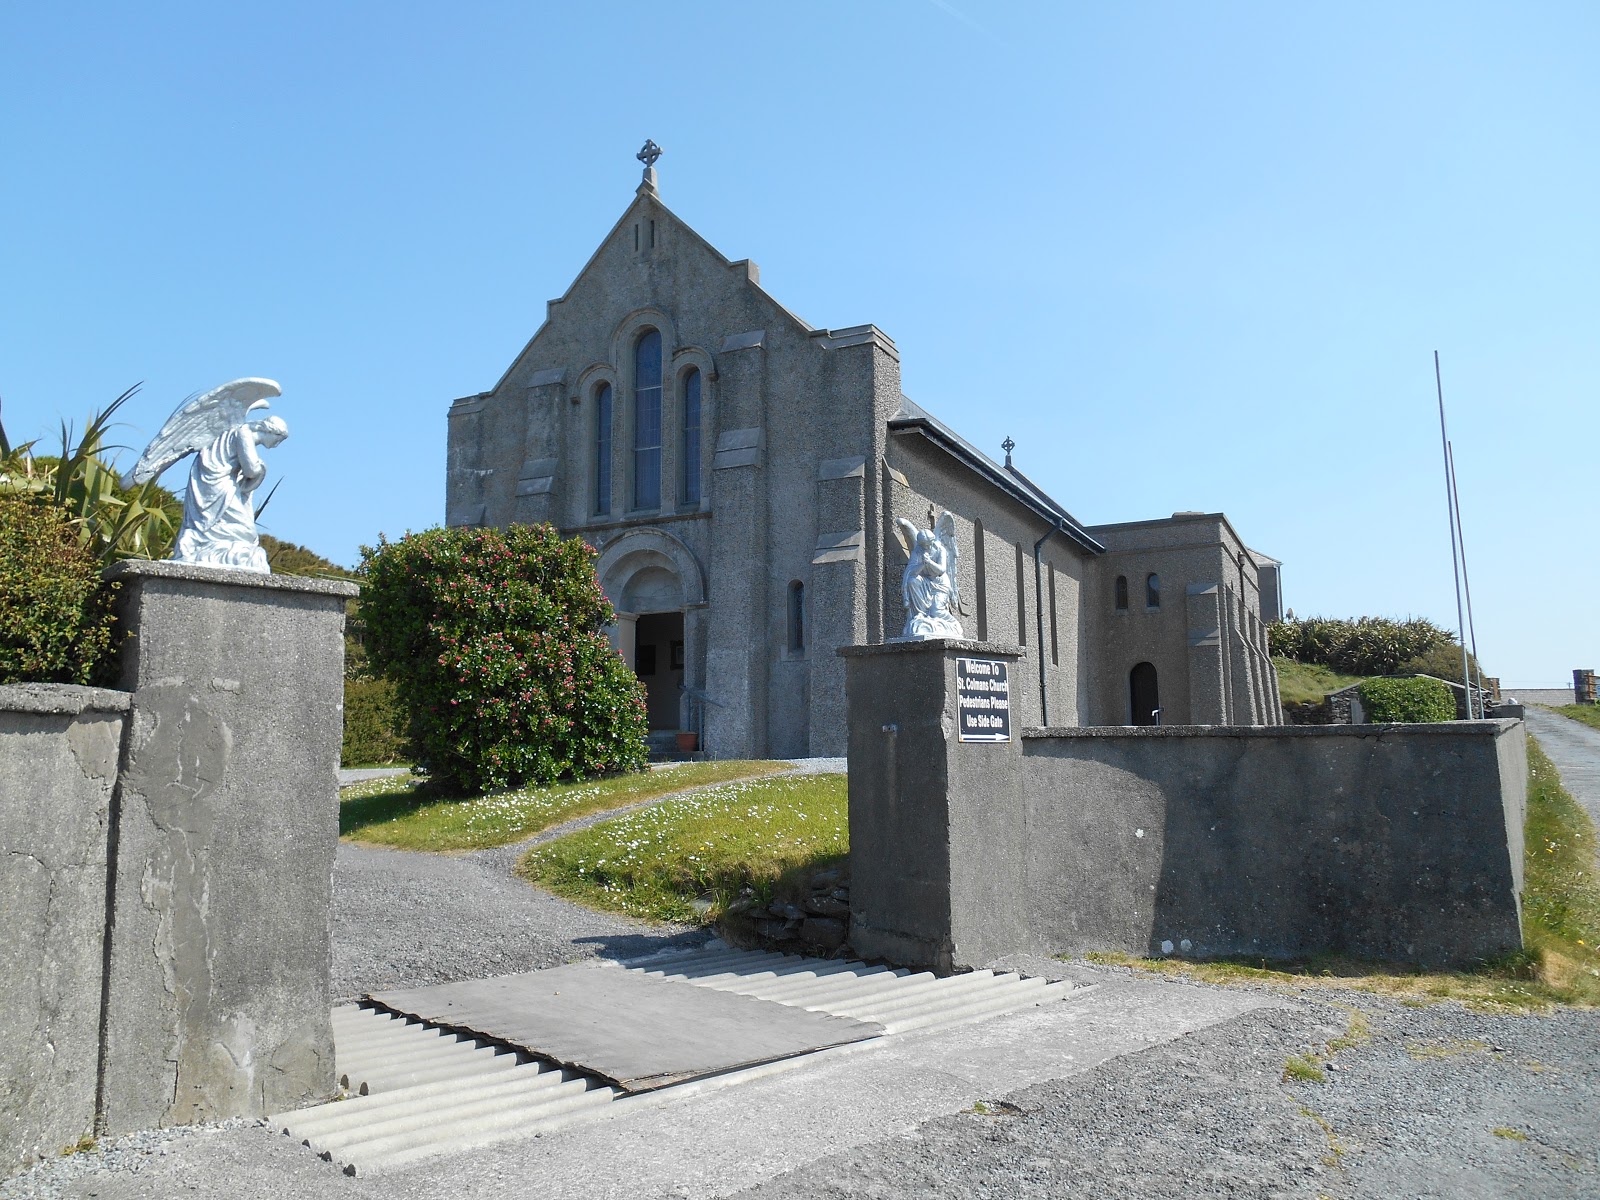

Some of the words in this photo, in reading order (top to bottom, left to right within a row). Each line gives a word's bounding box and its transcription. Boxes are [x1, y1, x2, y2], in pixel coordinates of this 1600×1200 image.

[965, 660, 990, 674] Welcome
[991, 662, 999, 675] To
[958, 677, 966, 690] St.
[966, 677, 989, 691] Colmans
[990, 679, 1007, 692] Church
[960, 695, 990, 709] Pedestrians
[991, 696, 1008, 709] Please
[967, 714, 977, 728] Use
[978, 714, 990, 728] Side
[990, 715, 1003, 728] Gate
